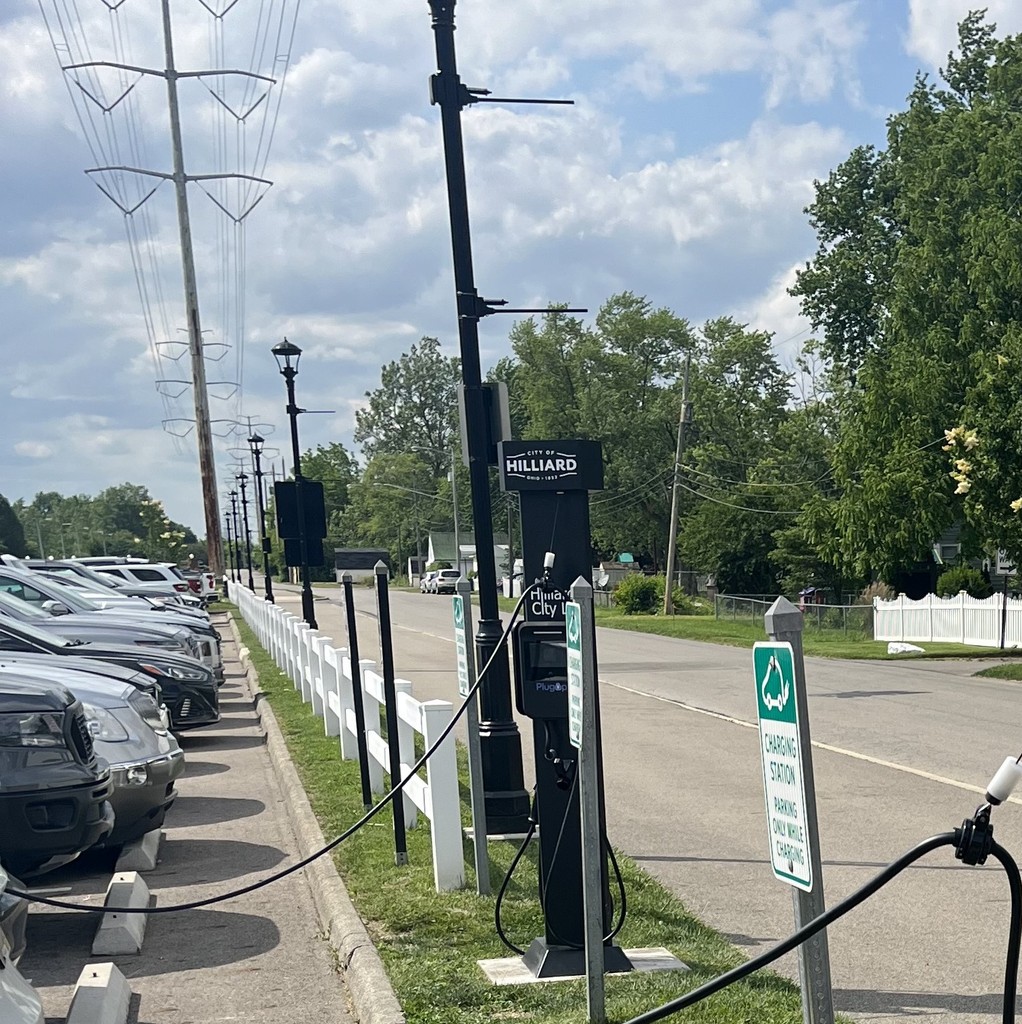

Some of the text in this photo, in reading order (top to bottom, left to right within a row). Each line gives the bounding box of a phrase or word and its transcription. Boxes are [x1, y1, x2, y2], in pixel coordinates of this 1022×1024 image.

[506, 459, 577, 472] HILLIARD
[532, 600, 557, 618] City
[765, 732, 796, 758] CHARGING
[770, 761, 796, 785] STATION
[774, 796, 797, 819] PARKING
[773, 818, 804, 843] ONLY WHILE
[777, 840, 804, 865] CHARGING
